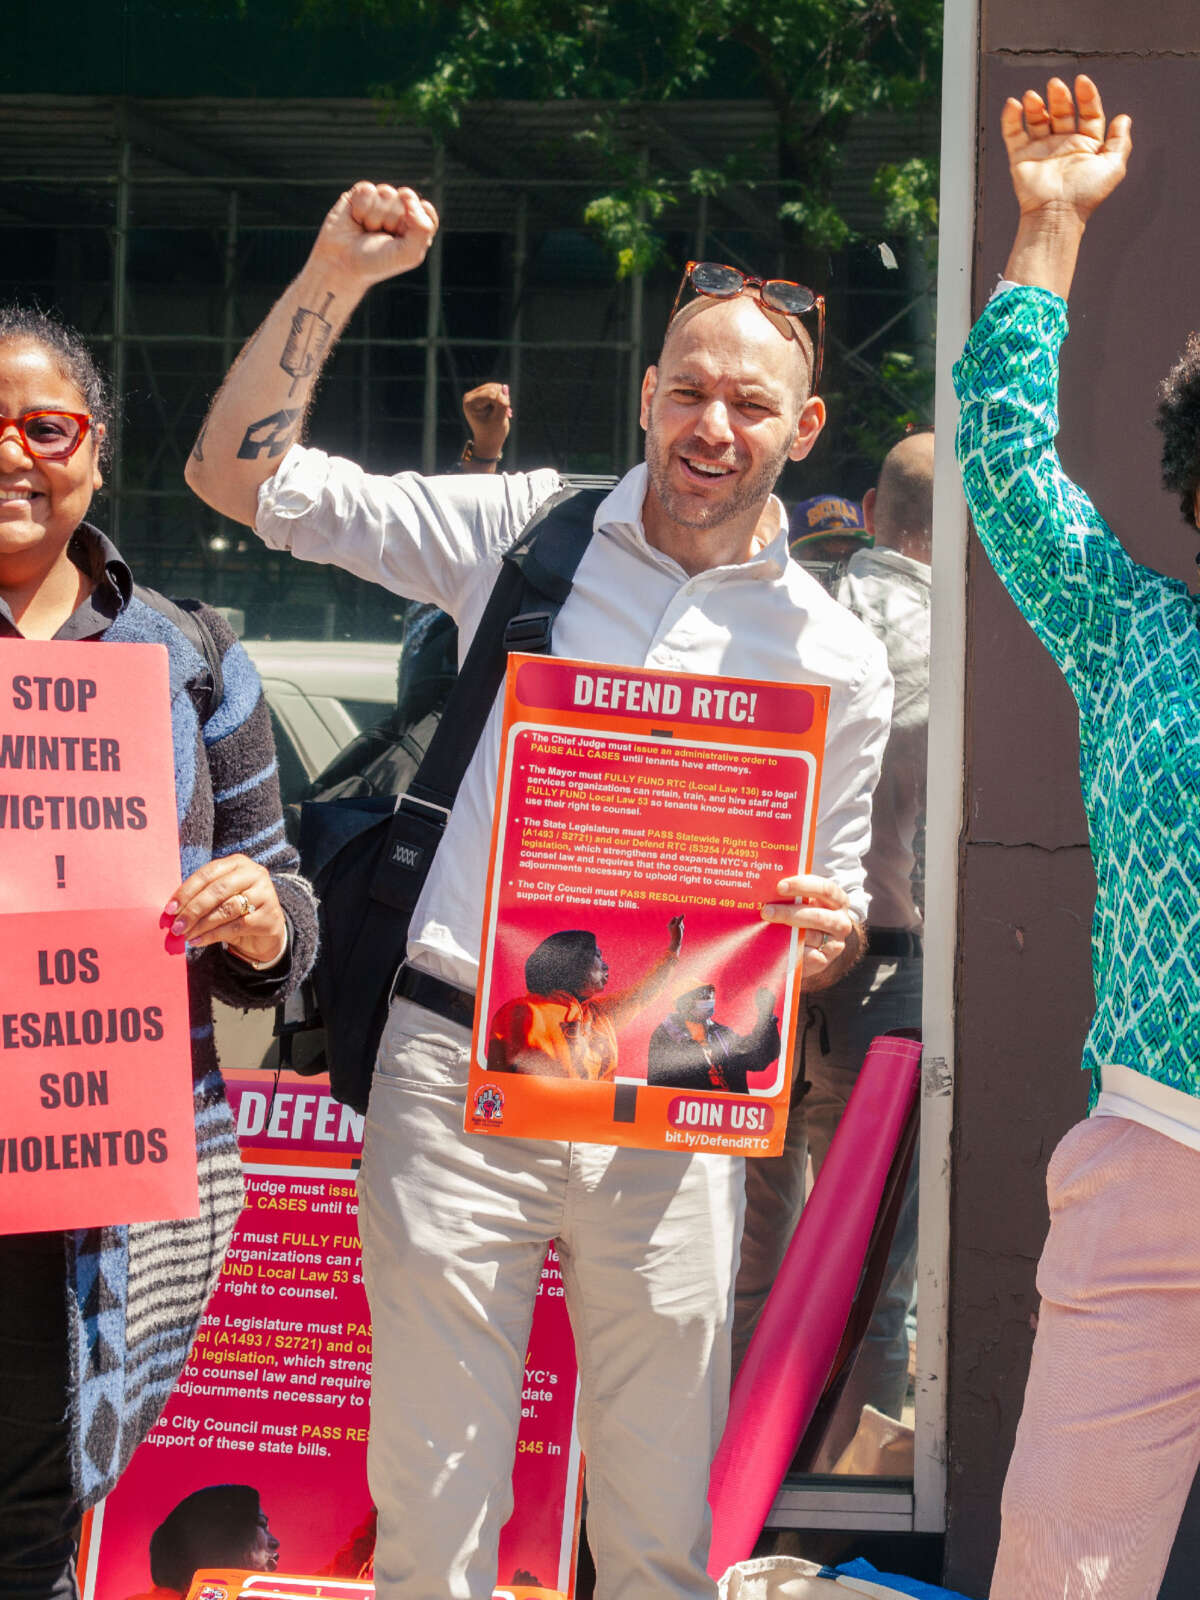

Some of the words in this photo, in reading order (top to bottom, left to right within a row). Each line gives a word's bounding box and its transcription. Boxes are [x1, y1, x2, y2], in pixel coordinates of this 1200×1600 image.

[12, 675, 97, 712] STOP
[573, 675, 682, 715] DEFEND
[691, 685, 759, 723] RTC!
[531, 743, 563, 754] PAUSE
[566, 747, 584, 757] ALL
[587, 749, 619, 760] CASES
[645, 756, 679, 766] tenants
[682, 759, 704, 769] have
[706, 763, 751, 774] attorneys.
[532, 732, 548, 742] The
[551, 735, 575, 745] Chief
[577, 738, 606, 749] Judge
[608, 742, 631, 751] must
[633, 744, 658, 754] issue
[674, 749, 738, 762] administrative
[741, 756, 766, 764] order
[527, 776, 565, 787] services
[568, 781, 631, 793] organizations
[652, 789, 680, 798] retain,
[683, 792, 705, 802] train,
[708, 795, 726, 803] and
[728, 796, 746, 804] hire
[748, 799, 769, 807] staff
[529, 764, 545, 774] The
[548, 766, 576, 778] Mayor
[578, 771, 601, 780] must
[604, 773, 635, 782] FULLY
[637, 776, 664, 785] FUND
[666, 779, 685, 787] RTC
[688, 781, 716, 791] (Local
[719, 784, 738, 793] Law
[775, 790, 797, 800] legal
[525, 797, 542, 805] use
[544, 798, 565, 808] their
[567, 801, 589, 811] right
[603, 806, 642, 815] counsel.
[55, 855, 66, 889] !
[516, 891, 552, 901] support
[554, 894, 564, 902] of
[566, 895, 591, 904] these
[593, 898, 615, 907] state
[618, 899, 639, 909] bills.
[38, 948, 100, 986] LOS
[40, 1070, 109, 1109] SON
[674, 1100, 727, 1128] JOIN
[730, 1105, 766, 1131] US!
[665, 1131, 770, 1150] bit.ly/DefendRTC
[243, 1176, 286, 1195] Judge
[290, 1184, 325, 1195] must
[257, 1197, 307, 1211] CASES
[311, 1201, 342, 1213] until
[242, 1232, 278, 1244] must
[282, 1232, 329, 1247] FULLY
[226, 1244, 321, 1264] organizations
[326, 1255, 351, 1265] can
[258, 1265, 296, 1279] Local
[300, 1268, 328, 1281] Law
[332, 1270, 348, 1282] 53
[224, 1280, 257, 1296] right
[261, 1283, 275, 1295] to
[278, 1286, 337, 1299] counsel.
[224, 1314, 303, 1332] Legislature
[307, 1323, 342, 1334] must
[214, 1331, 262, 1346] (A1493
[266, 1335, 271, 1347] /
[274, 1335, 322, 1353] S2721)
[326, 1340, 352, 1352] and
[202, 1348, 278, 1367] legislation,
[283, 1354, 325, 1368] which
[184, 1363, 198, 1376] to
[202, 1368, 258, 1381] counsel
[262, 1369, 286, 1382] law
[290, 1373, 316, 1385] and
[172, 1380, 268, 1399] adjournments
[273, 1390, 346, 1407] necessary
[350, 1393, 364, 1406] to
[142, 1434, 195, 1448] upport
[198, 1435, 214, 1448] of
[216, 1436, 254, 1451] these
[258, 1440, 293, 1453] state
[298, 1442, 330, 1456] bills.
[172, 1415, 200, 1432] City
[204, 1417, 258, 1433] Council
[261, 1424, 298, 1436] must
[302, 1424, 341, 1439] PASS
[518, 1440, 543, 1453] 345
[548, 1442, 560, 1455] in
